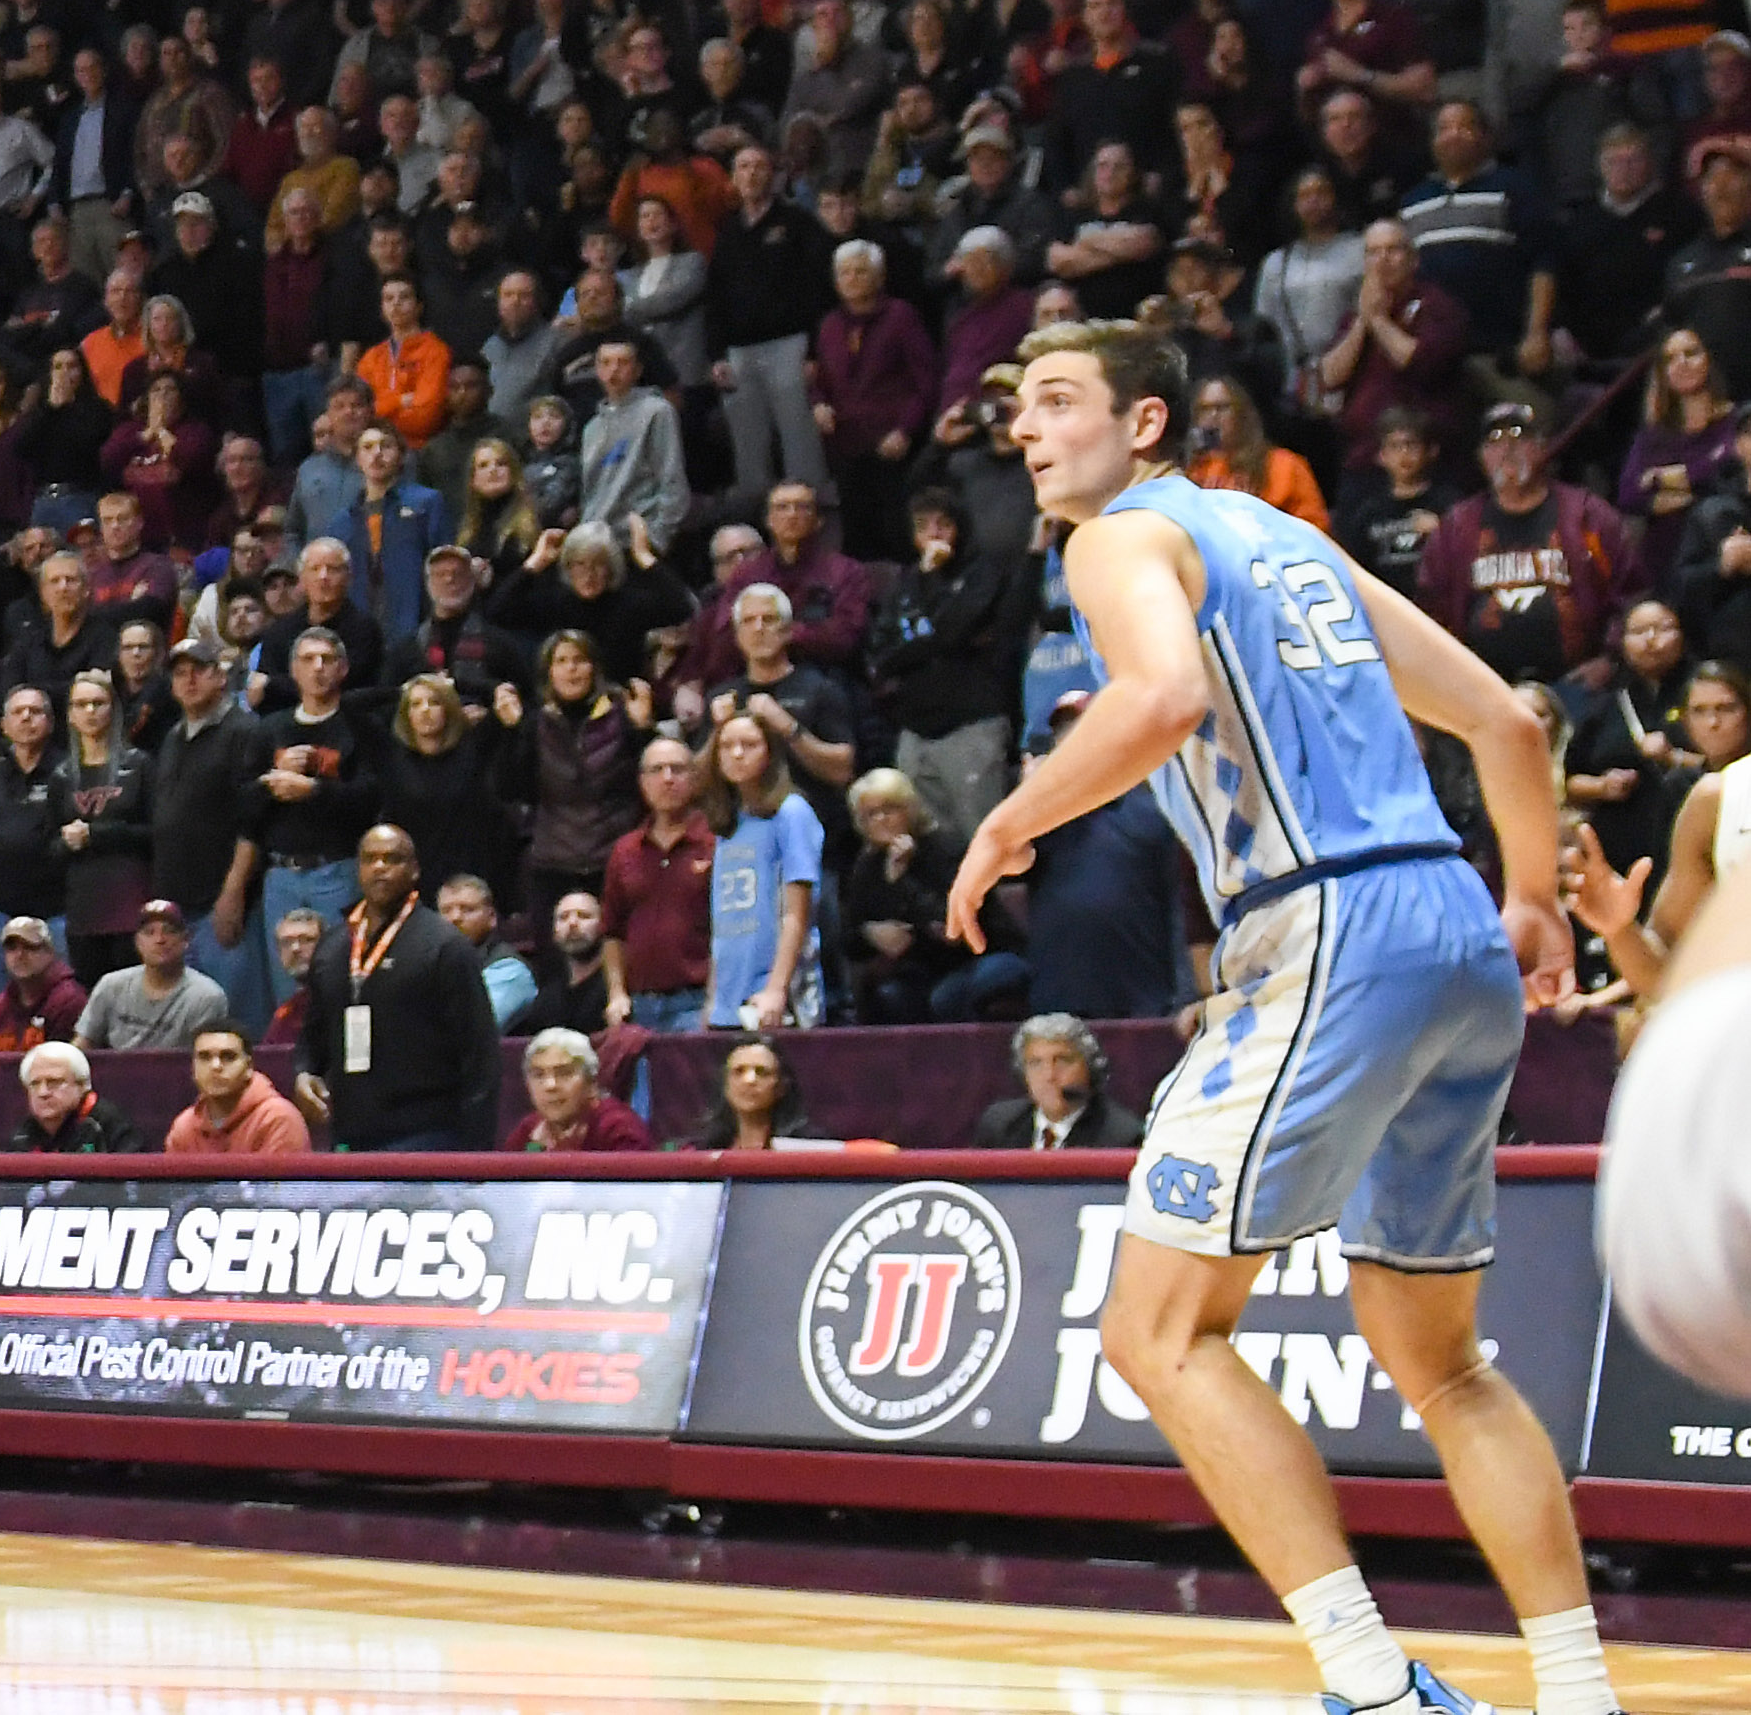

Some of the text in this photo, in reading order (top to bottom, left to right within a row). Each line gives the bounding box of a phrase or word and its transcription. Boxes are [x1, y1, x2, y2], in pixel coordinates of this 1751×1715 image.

[1250, 558, 1383, 671] 32
[720, 868, 758, 913] 23
[167, 1207, 506, 1315] SERVICES,
[525, 1210, 674, 1304] INC.
[924, 1200, 1006, 1314] JOHN'S
[849, 1253, 969, 1377] JJ
[81, 1336, 144, 1380] Pest
[142, 1338, 246, 1385] Control
[243, 1341, 348, 1389] Partner
[346, 1346, 385, 1391] of
[380, 1346, 430, 1392] the
[439, 1348, 645, 1404] HOKIES
[1670, 1425, 1733, 1457] THE
